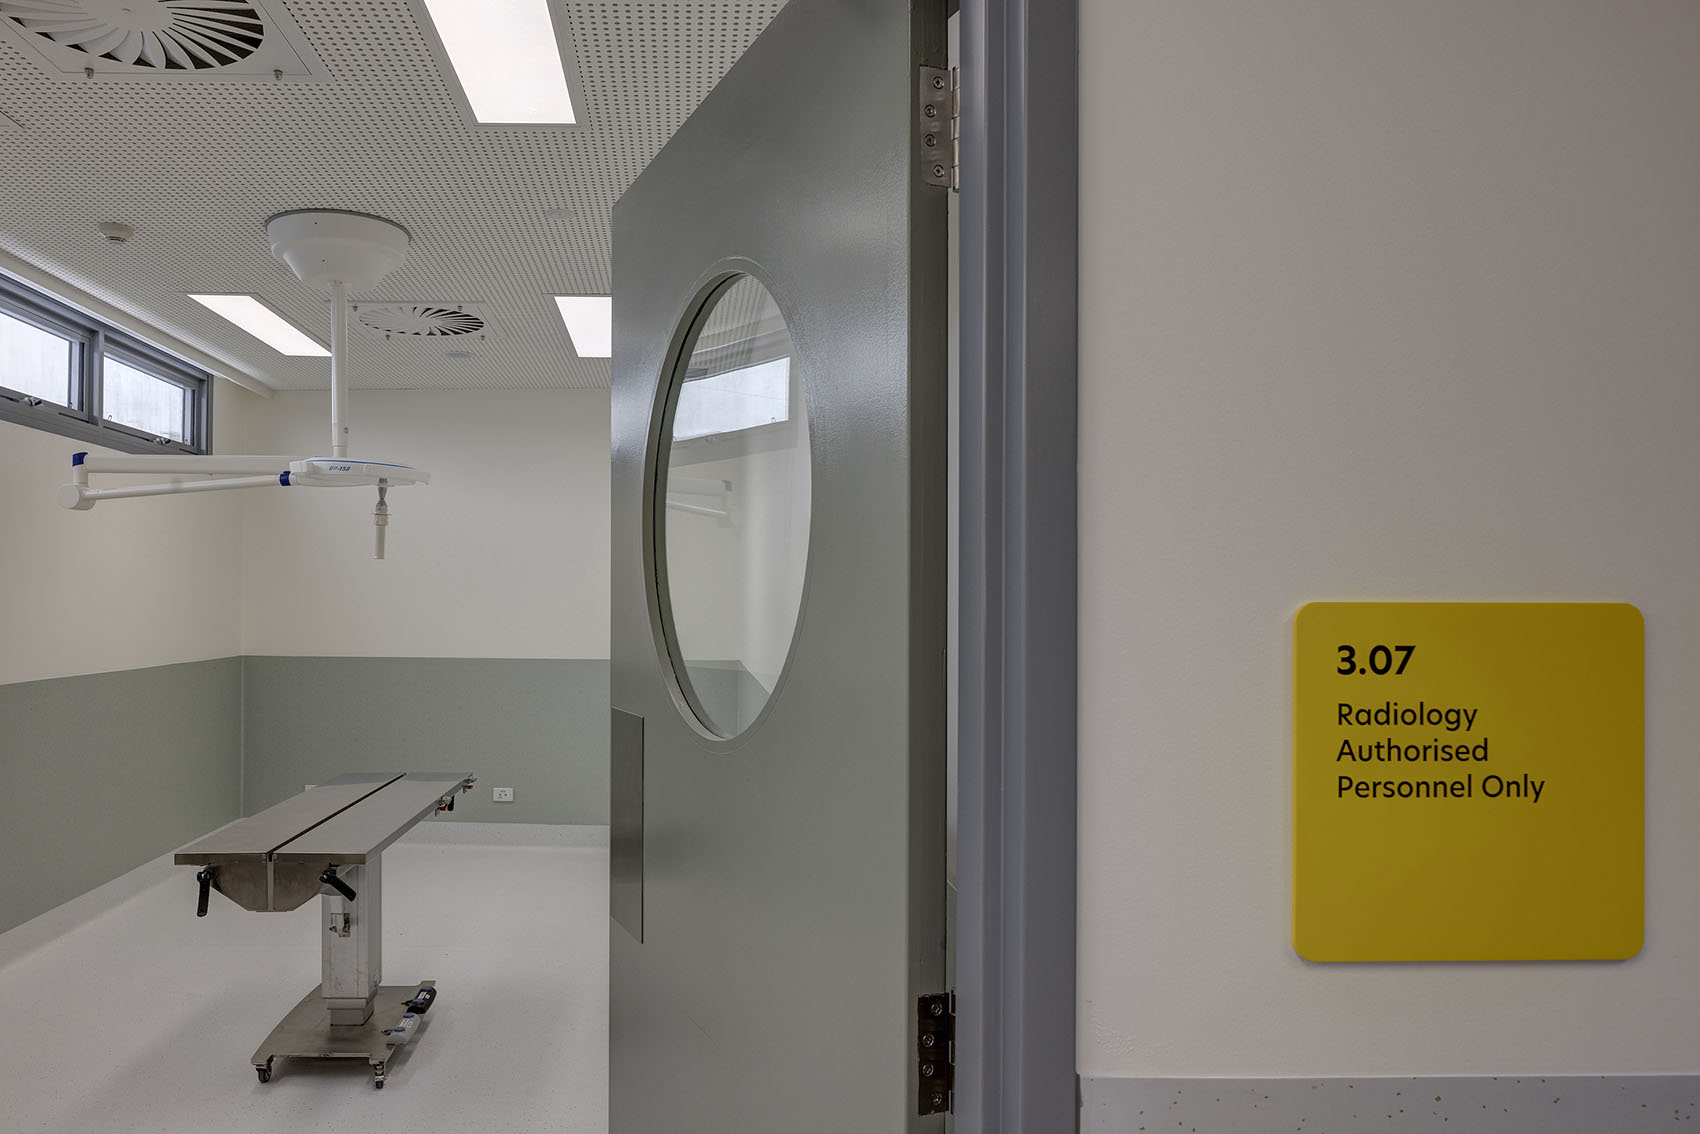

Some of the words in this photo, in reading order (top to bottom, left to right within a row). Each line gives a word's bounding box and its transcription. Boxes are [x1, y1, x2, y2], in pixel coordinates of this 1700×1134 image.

[1337, 644, 1416, 676] 3.07
[1337, 701, 1478, 732] Radiology
[1336, 737, 1489, 762] Authorised
[1337, 773, 1472, 799] Personnel
[1481, 773, 1545, 804] Only
